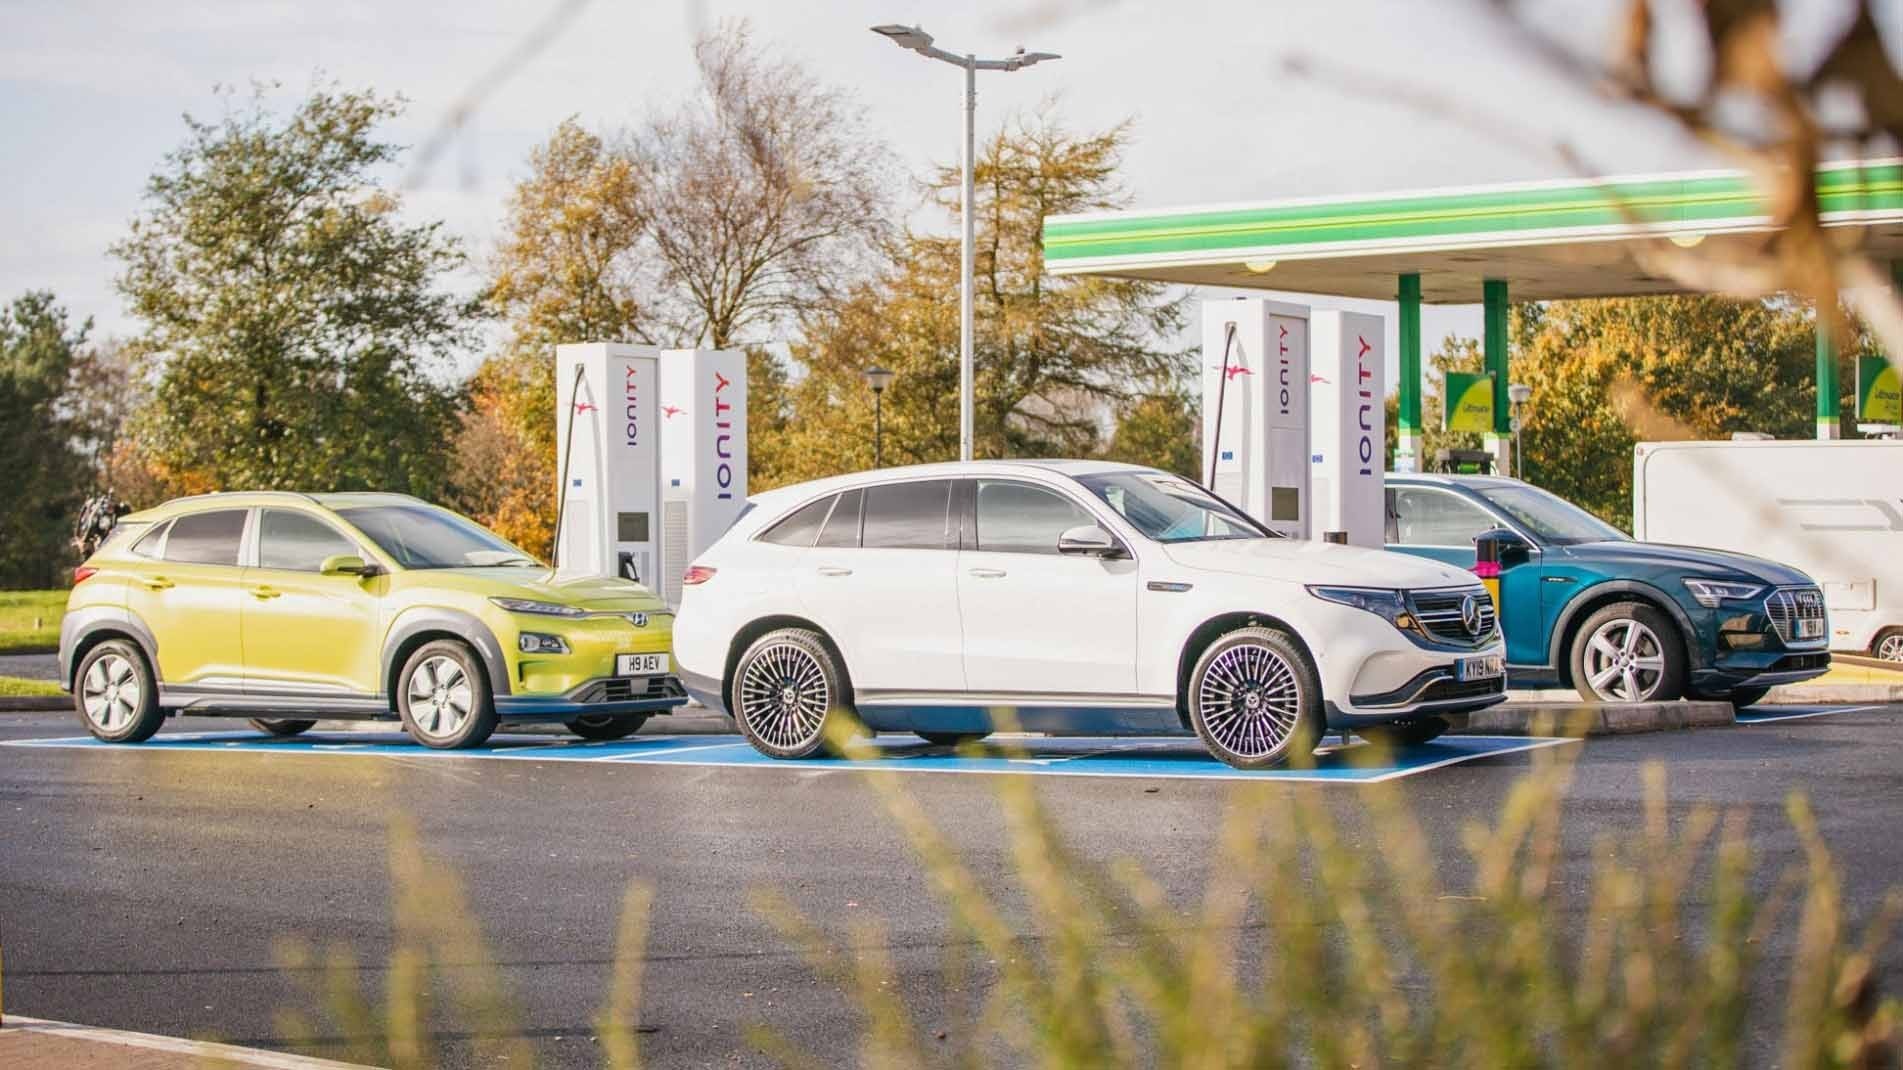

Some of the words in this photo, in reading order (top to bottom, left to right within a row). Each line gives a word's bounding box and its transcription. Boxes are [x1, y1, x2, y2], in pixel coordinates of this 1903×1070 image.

[626, 365, 637, 447] IONITY
[1279, 324, 1289, 414] IONITY
[1358, 335, 1372, 476] IONITY
[715, 371, 732, 499] IONITY
[629, 656, 641, 671] H9
[643, 656, 660, 671] AEV
